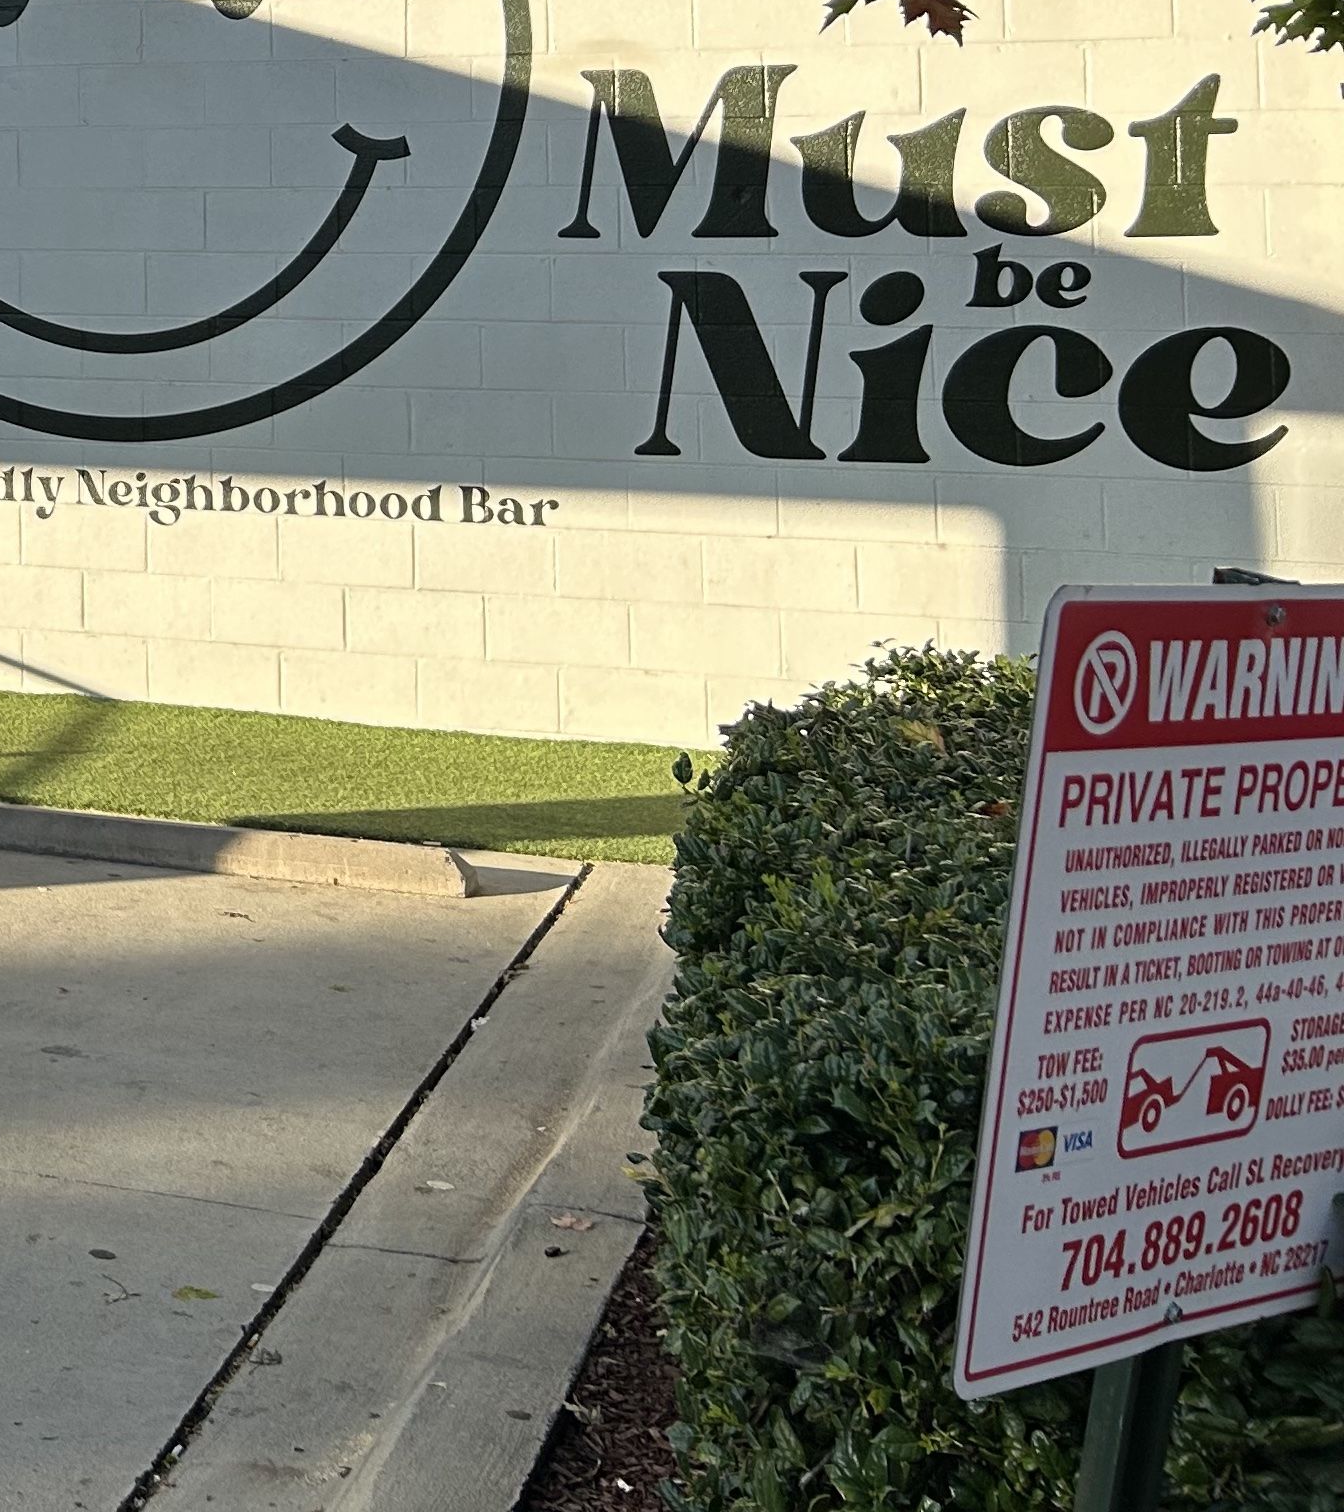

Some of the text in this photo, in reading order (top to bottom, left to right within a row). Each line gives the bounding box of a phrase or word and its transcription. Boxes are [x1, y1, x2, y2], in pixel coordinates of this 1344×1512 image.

[557, 64, 1239, 239] Must
[965, 243, 1092, 309] be
[634, 270, 1291, 473] Nice
[75, 468, 445, 526] Neighborhood
[458, 484, 560, 527] Bar
[1058, 766, 1226, 829] PRIVATE
[1065, 841, 1175, 873] UNAUTHORIZED,
[1181, 835, 1249, 864] ILLEGALLY
[1252, 830, 1303, 857] PARKED
[1306, 829, 1323, 852] OR
[1061, 884, 1133, 913] VEHICLES,
[1140, 875, 1230, 905] IMPROPERLY
[1233, 866, 1313, 896] REGISTERED
[1317, 864, 1335, 886] OR
[1054, 928, 1085, 954] NOT
[1091, 925, 1108, 949] IN
[1113, 915, 1208, 948] COMPLIANCE
[1214, 910, 1250, 936] WITH
[1255, 906, 1286, 930] THIS
[1049, 965, 1101, 994] RESULT
[1103, 962, 1118, 987] IN
[1120, 962, 1130, 986] A
[1135, 956, 1182, 984] TICKET,
[1187, 949, 1242, 976] BOOTING
[1245, 946, 1263, 968] OR
[1266, 939, 1313, 966] TOWING
[1315, 937, 1332, 958] AT
[1043, 1003, 1112, 1034] EXPENSE
[1119, 998, 1147, 1025] PER
[1154, 995, 1174, 1019] NC
[1038, 1047, 1103, 1080] TOW FEE:
[1281, 1045, 1325, 1076] $35.00
[1017, 1078, 1108, 1119] $250-$1,500
[1266, 1091, 1306, 1121] DOLLY
[1307, 1088, 1333, 1114] FEE:
[1063, 1130, 1093, 1153] VISA
[1021, 1147, 1344, 1235] For Towed Vehicles Call SL Recovery
[1060, 1189, 1304, 1292] 704.889.2608
[1012, 1240, 1329, 1343] 542 Rountree Road Charlotte NC 28217
